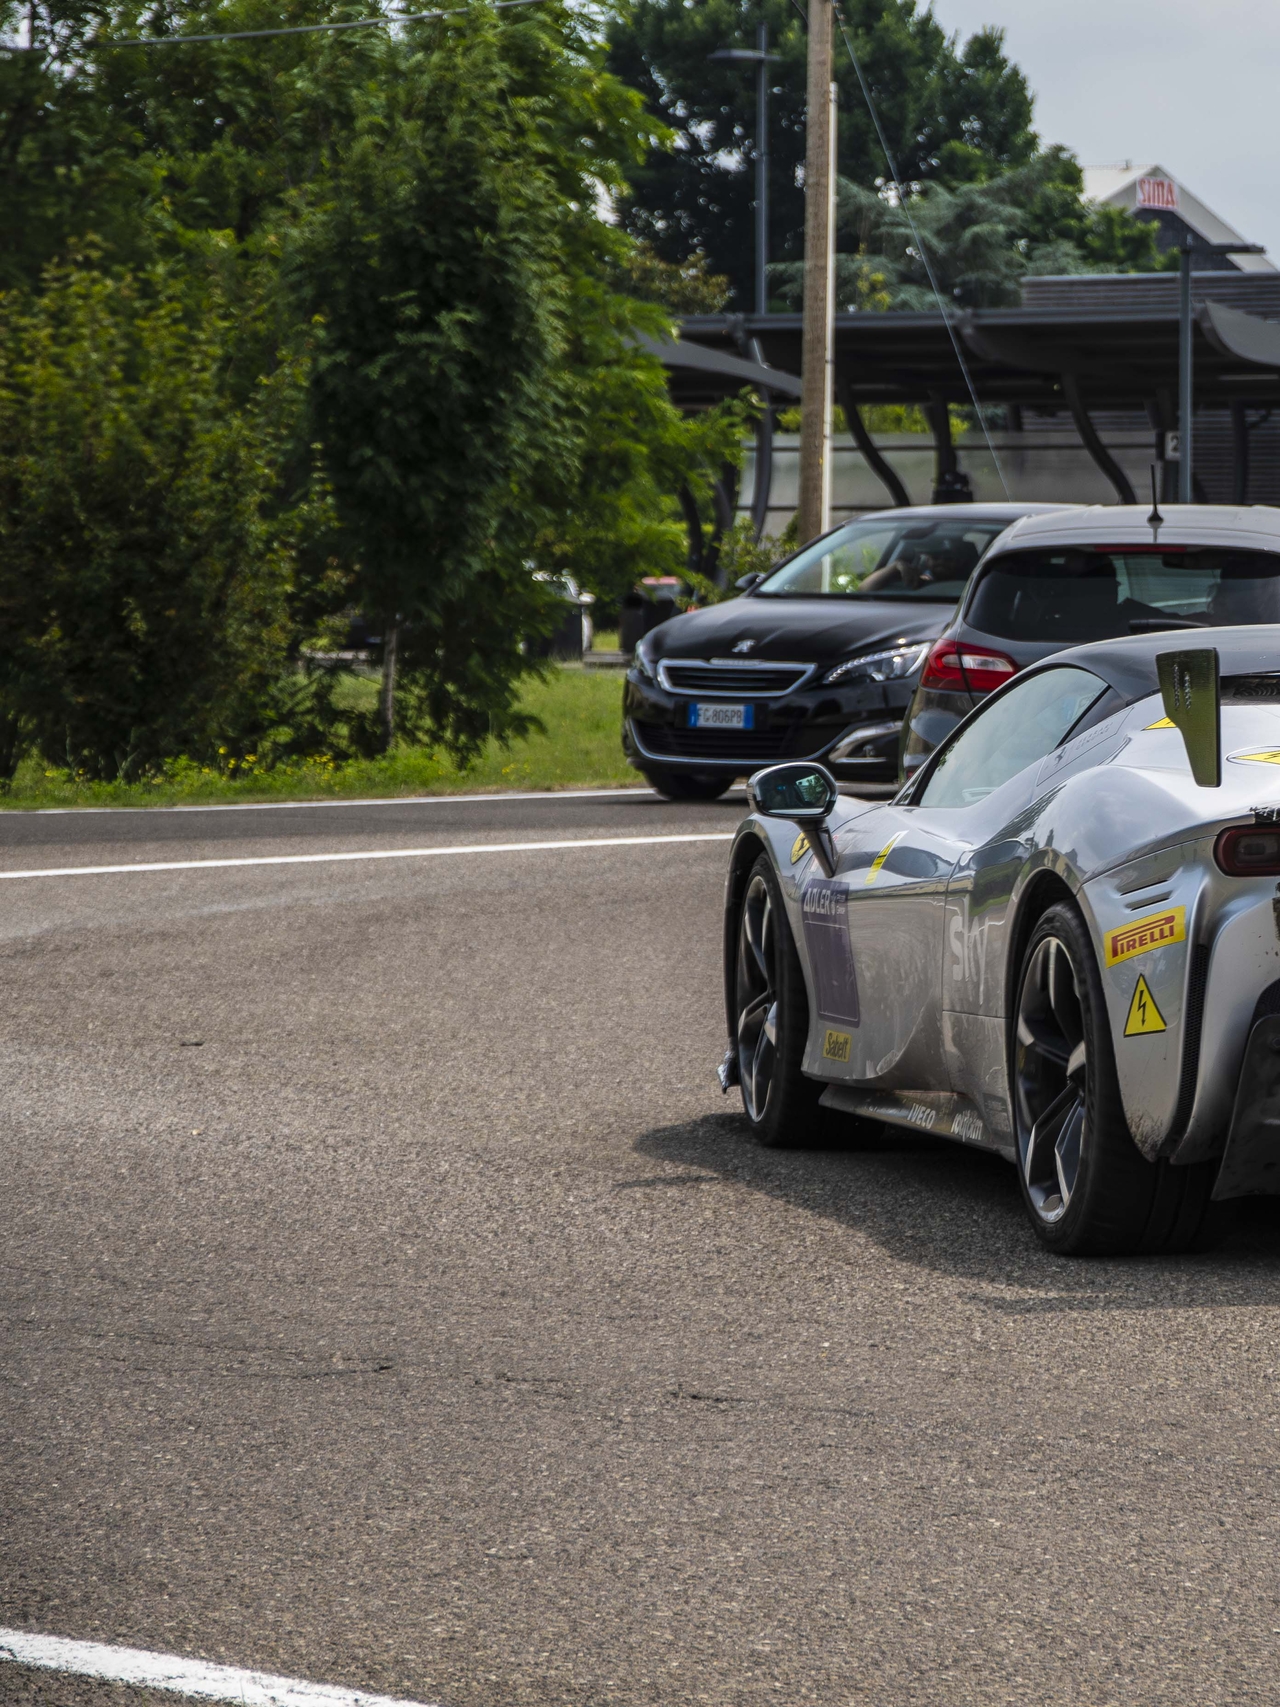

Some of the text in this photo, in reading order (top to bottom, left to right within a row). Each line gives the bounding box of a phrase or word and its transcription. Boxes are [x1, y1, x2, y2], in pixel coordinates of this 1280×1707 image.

[1137, 177, 1176, 207] SIMA
[1170, 434, 1180, 451] 2
[803, 887, 831, 915] ADLER
[1111, 914, 1176, 959] PIRELLI
[825, 1032, 849, 1060] Sabelt
[906, 1102, 936, 1130] IVECO
